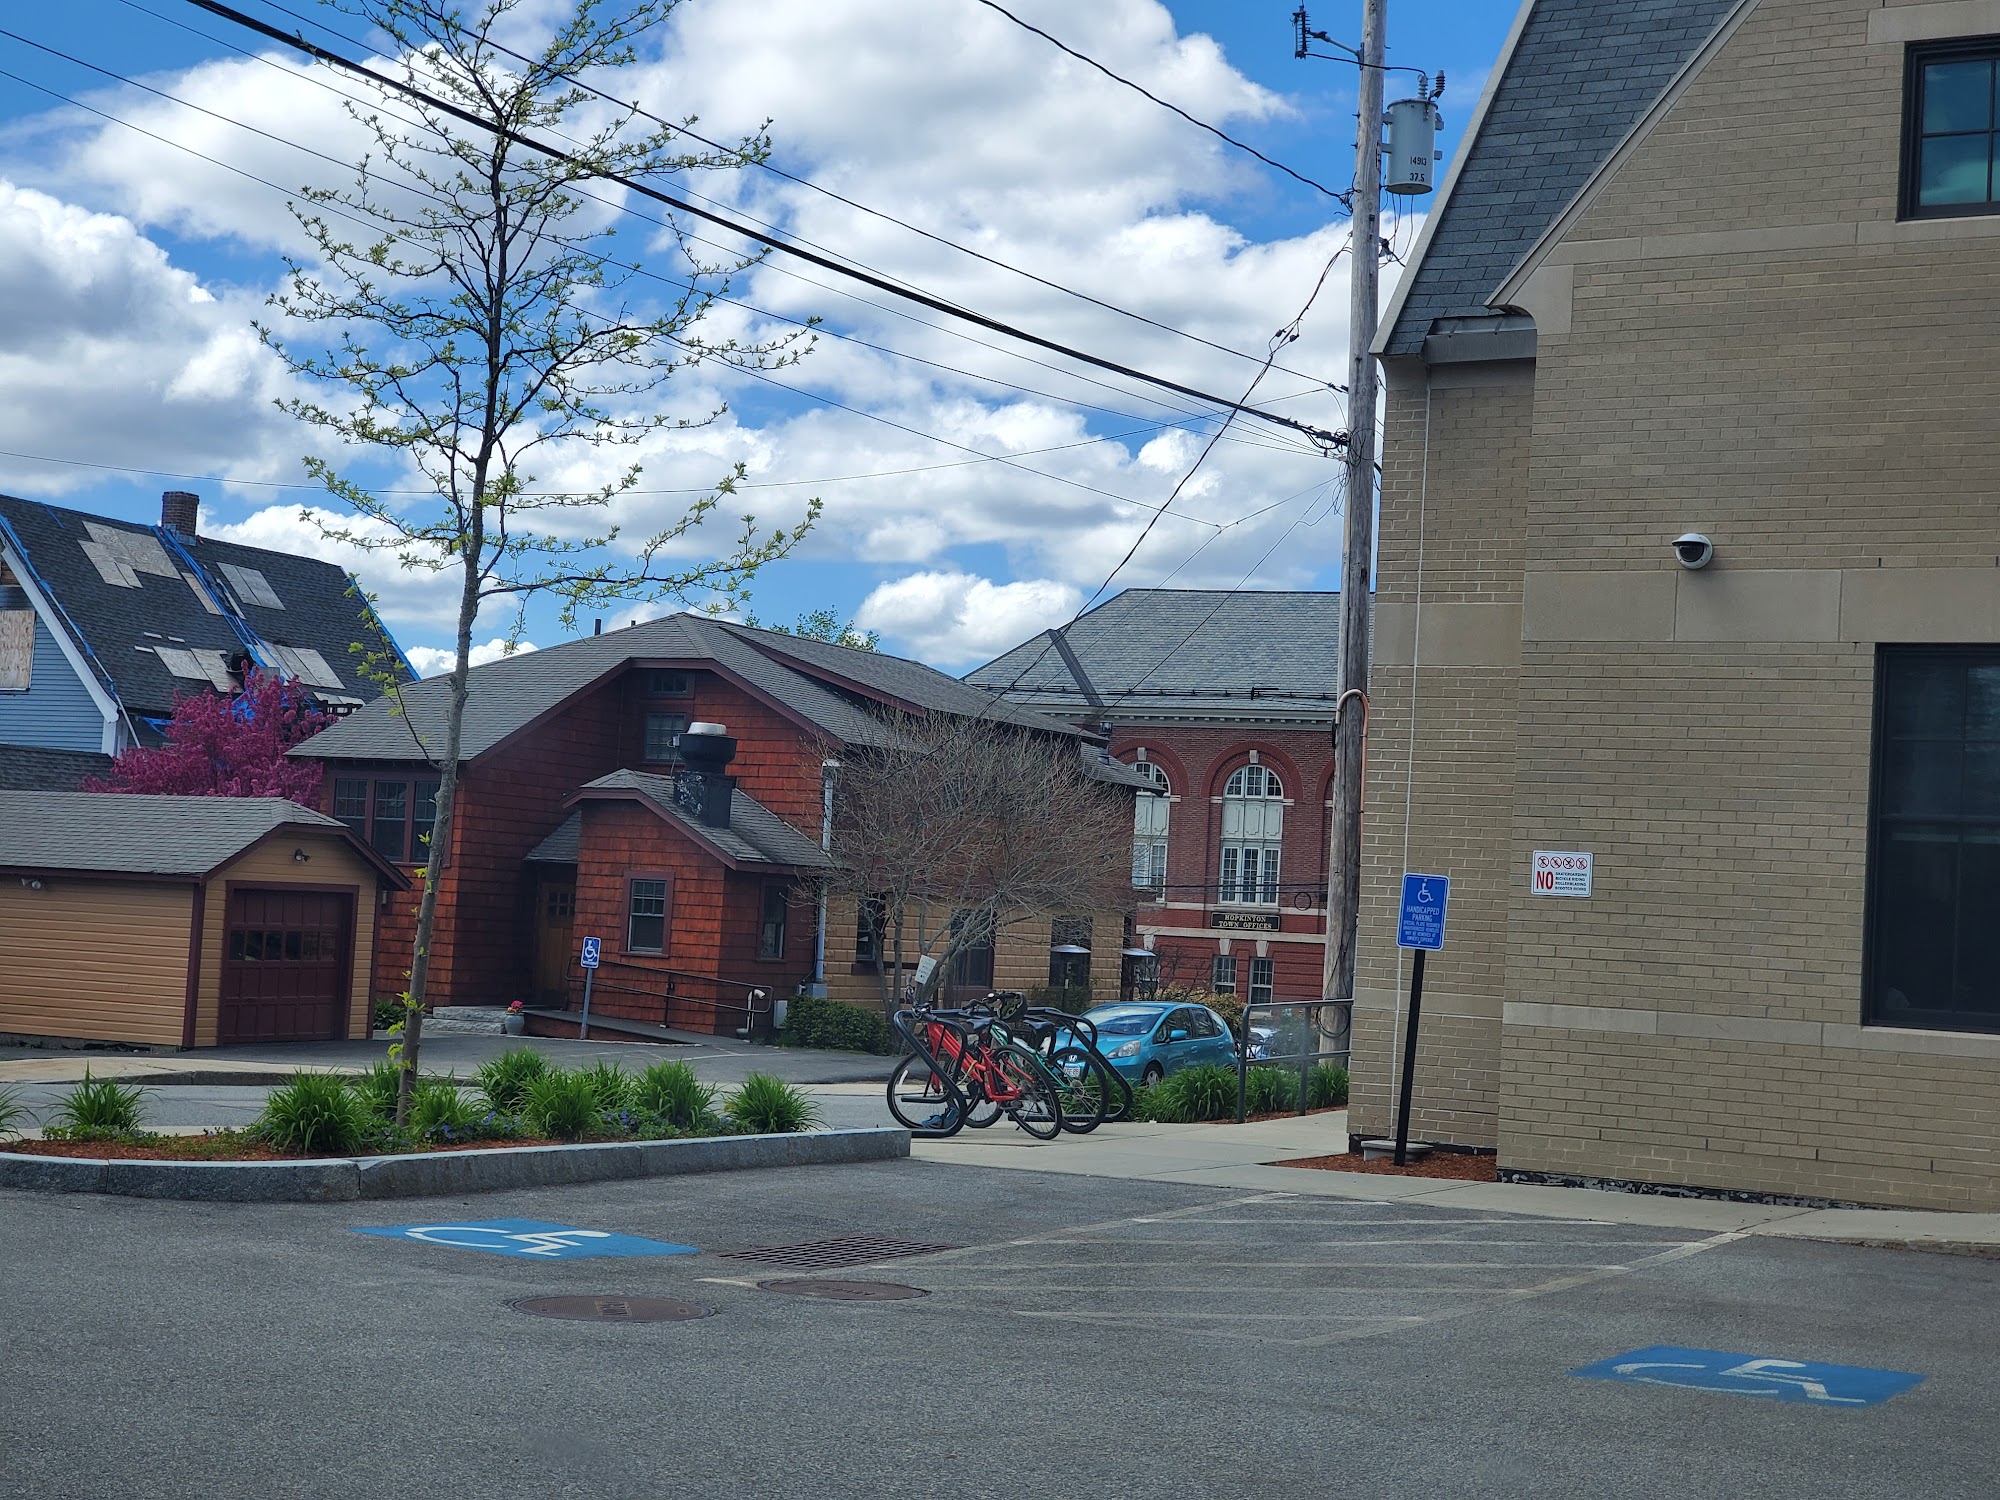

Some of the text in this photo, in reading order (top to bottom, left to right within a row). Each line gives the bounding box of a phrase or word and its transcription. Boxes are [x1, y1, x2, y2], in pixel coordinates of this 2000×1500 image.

[1409, 172, 1425, 182] 37.5
[1536, 870, 1554, 890] NO
[1406, 905, 1440, 915] HANDICAPPED
[1224, 914, 1266, 922] HOPKINTON
[1412, 913, 1432, 922] PARKING
